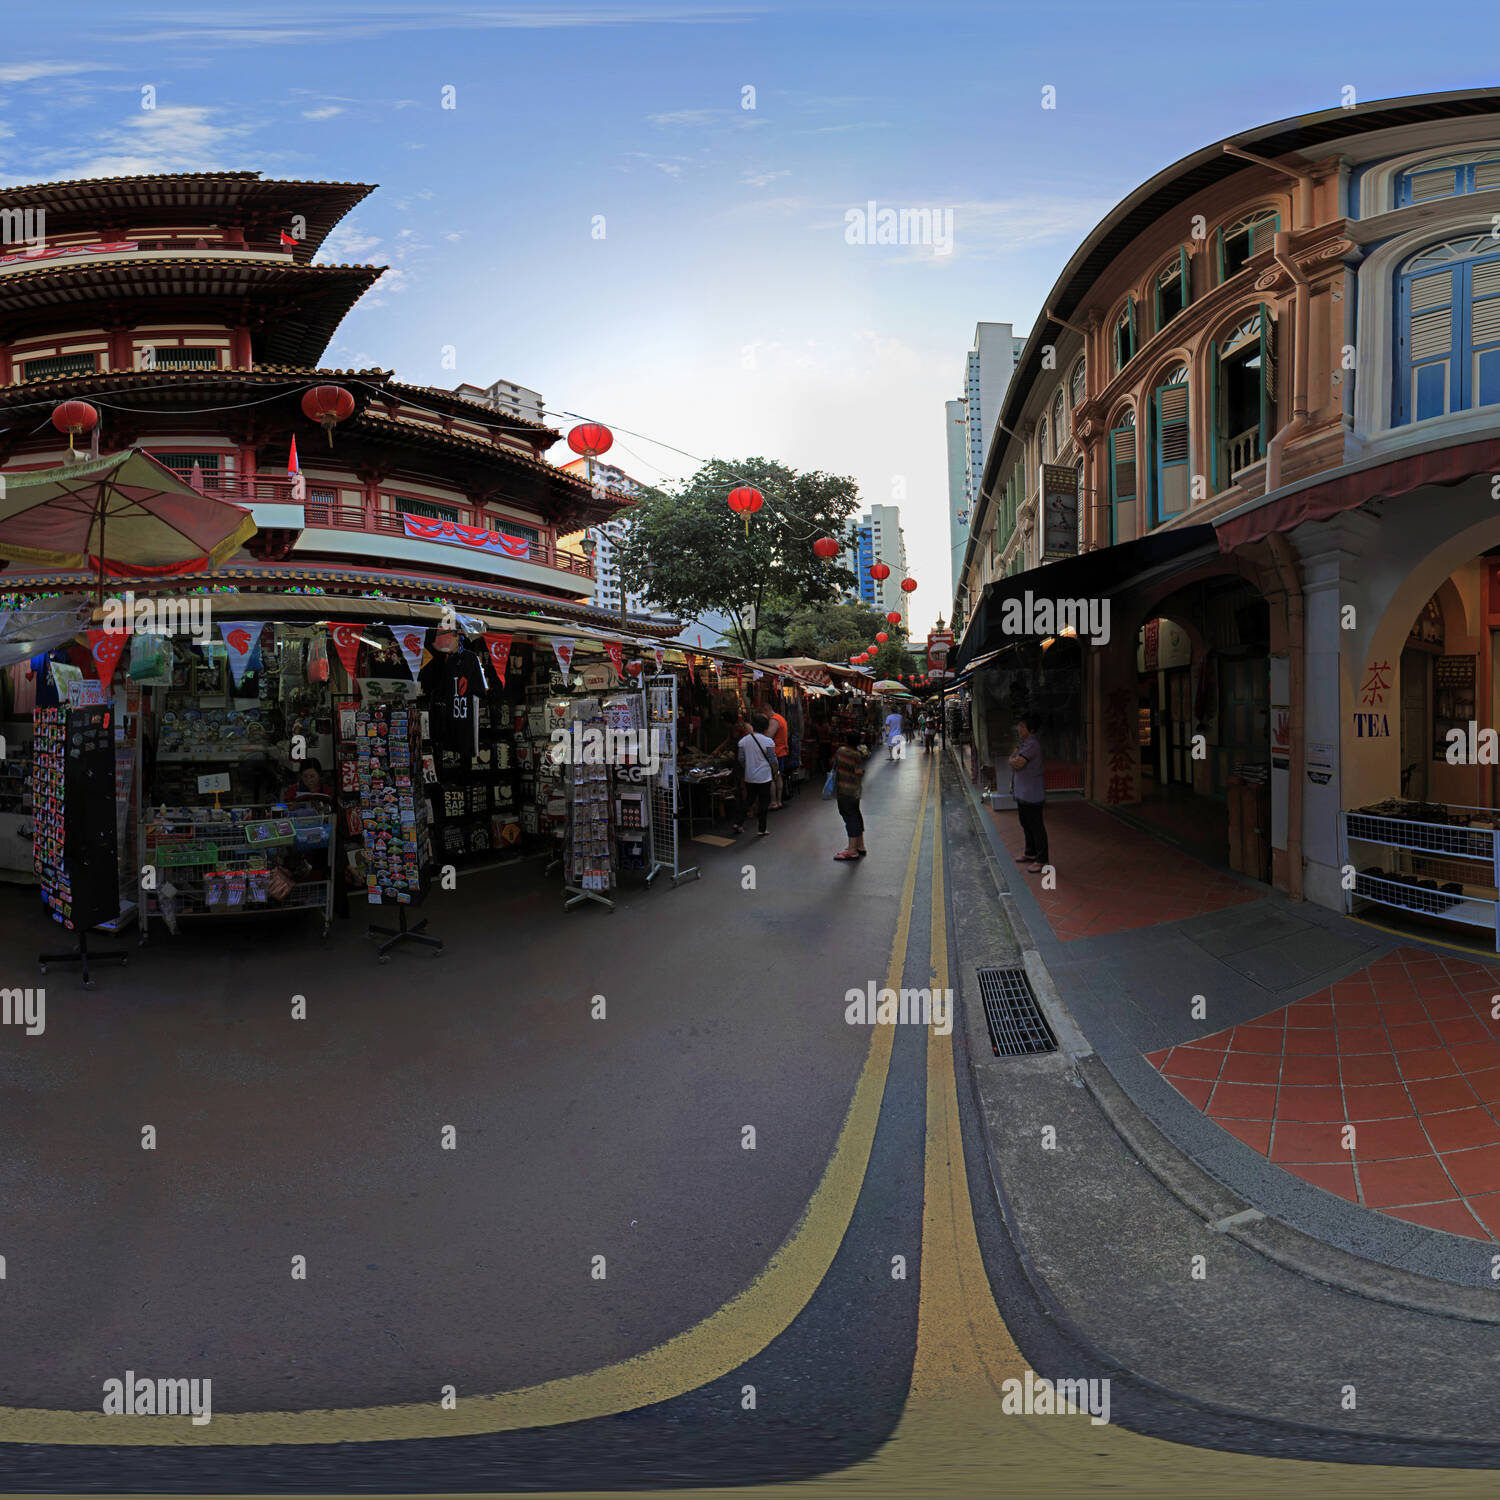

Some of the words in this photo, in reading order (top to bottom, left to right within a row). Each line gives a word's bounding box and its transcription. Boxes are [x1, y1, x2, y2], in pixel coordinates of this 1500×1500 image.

[1360, 660, 1391, 706] 茶
[453, 697, 468, 718] SG
[1353, 713, 1390, 738] TEA
